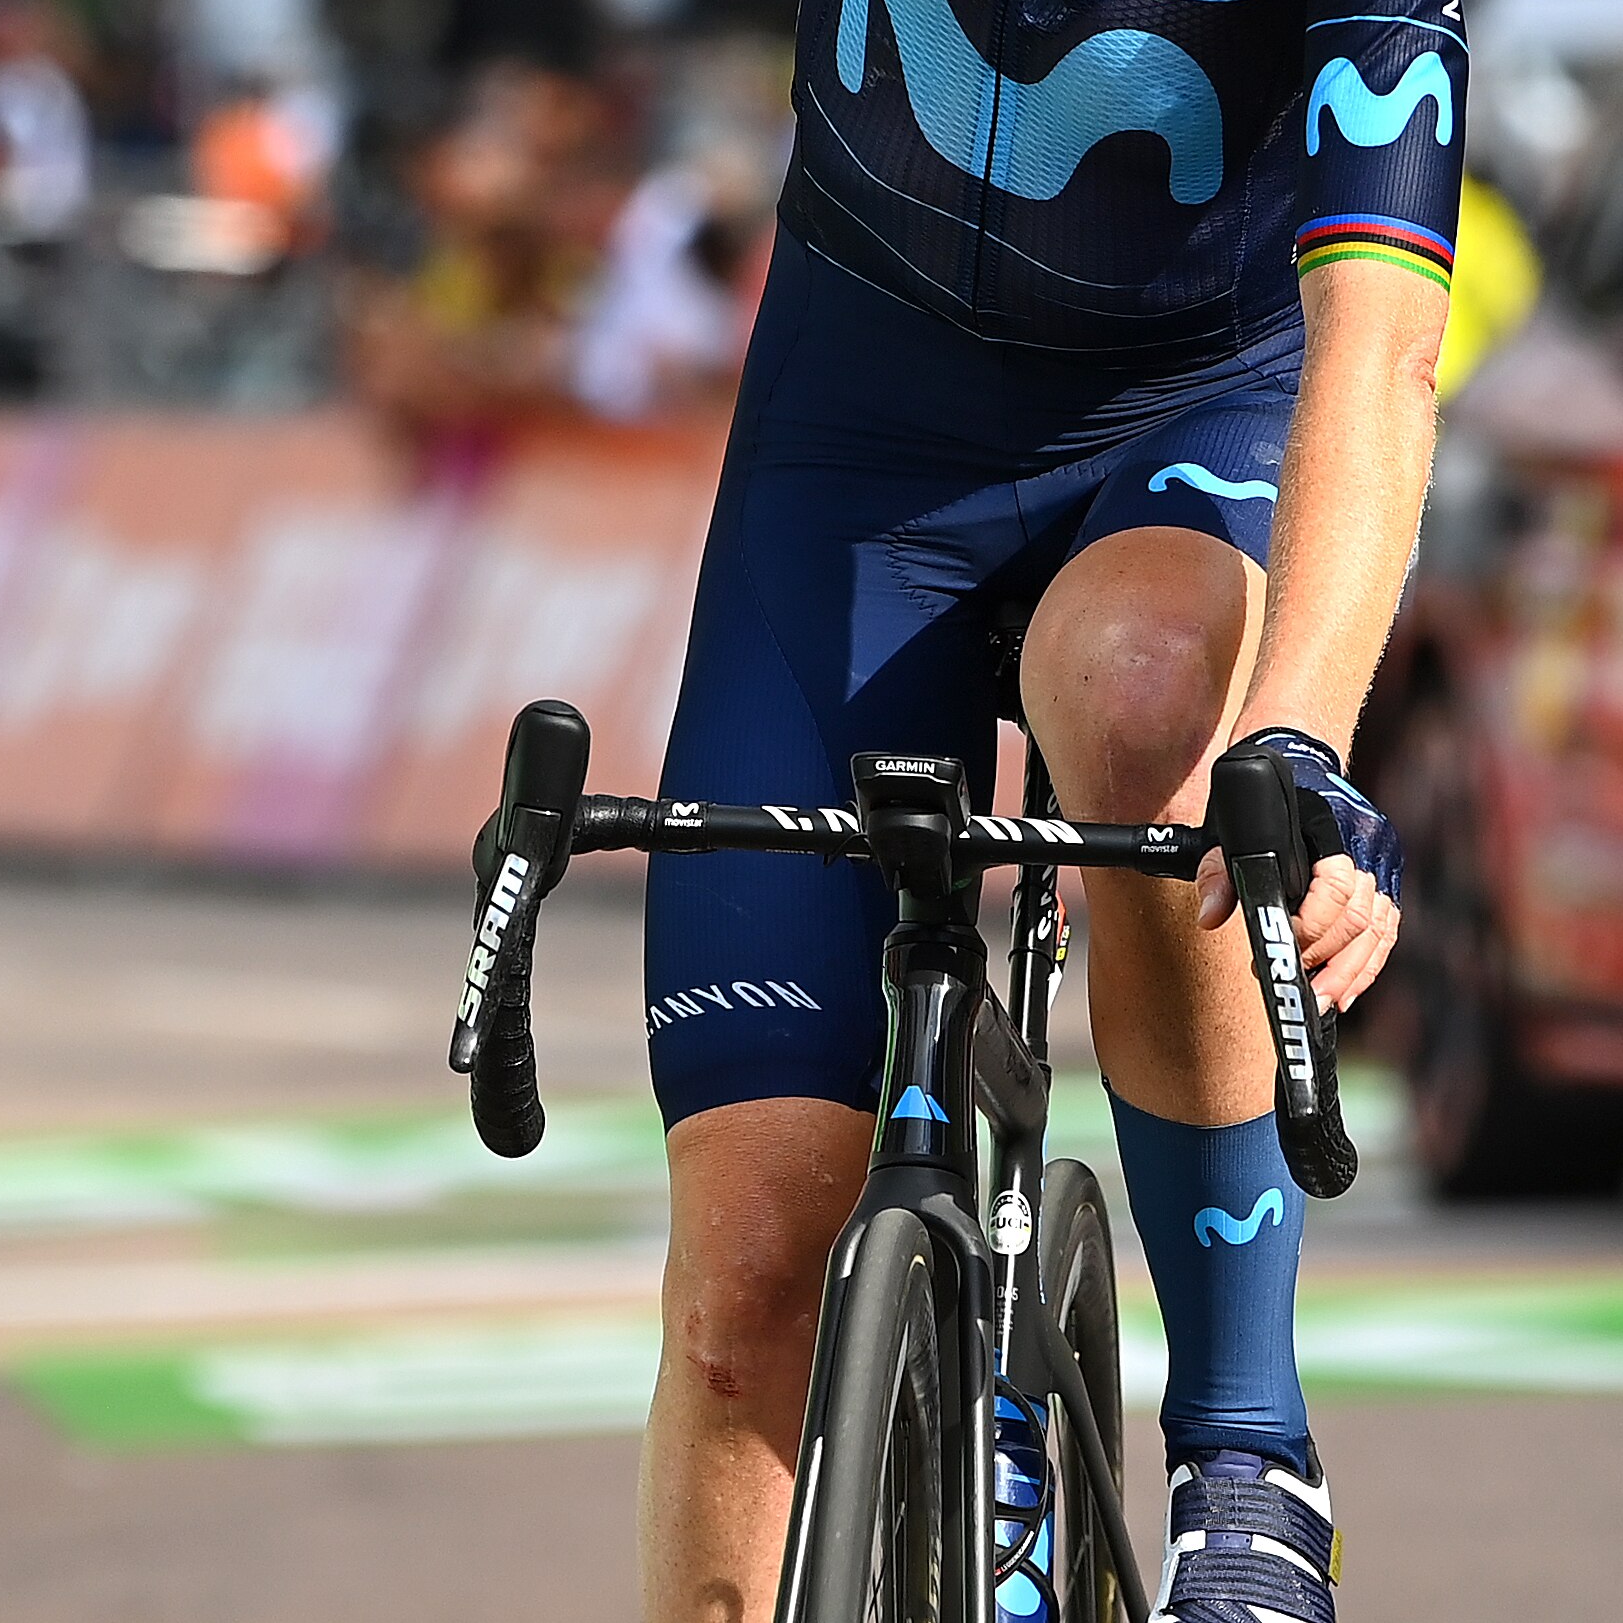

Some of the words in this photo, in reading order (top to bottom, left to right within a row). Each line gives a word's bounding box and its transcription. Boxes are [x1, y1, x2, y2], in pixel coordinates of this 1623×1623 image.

[875, 760, 935, 774] GARMIN
[1140, 843, 1179, 854] movistar
[457, 852, 530, 1028] SRAM
[1256, 906, 1314, 1080] SRAM
